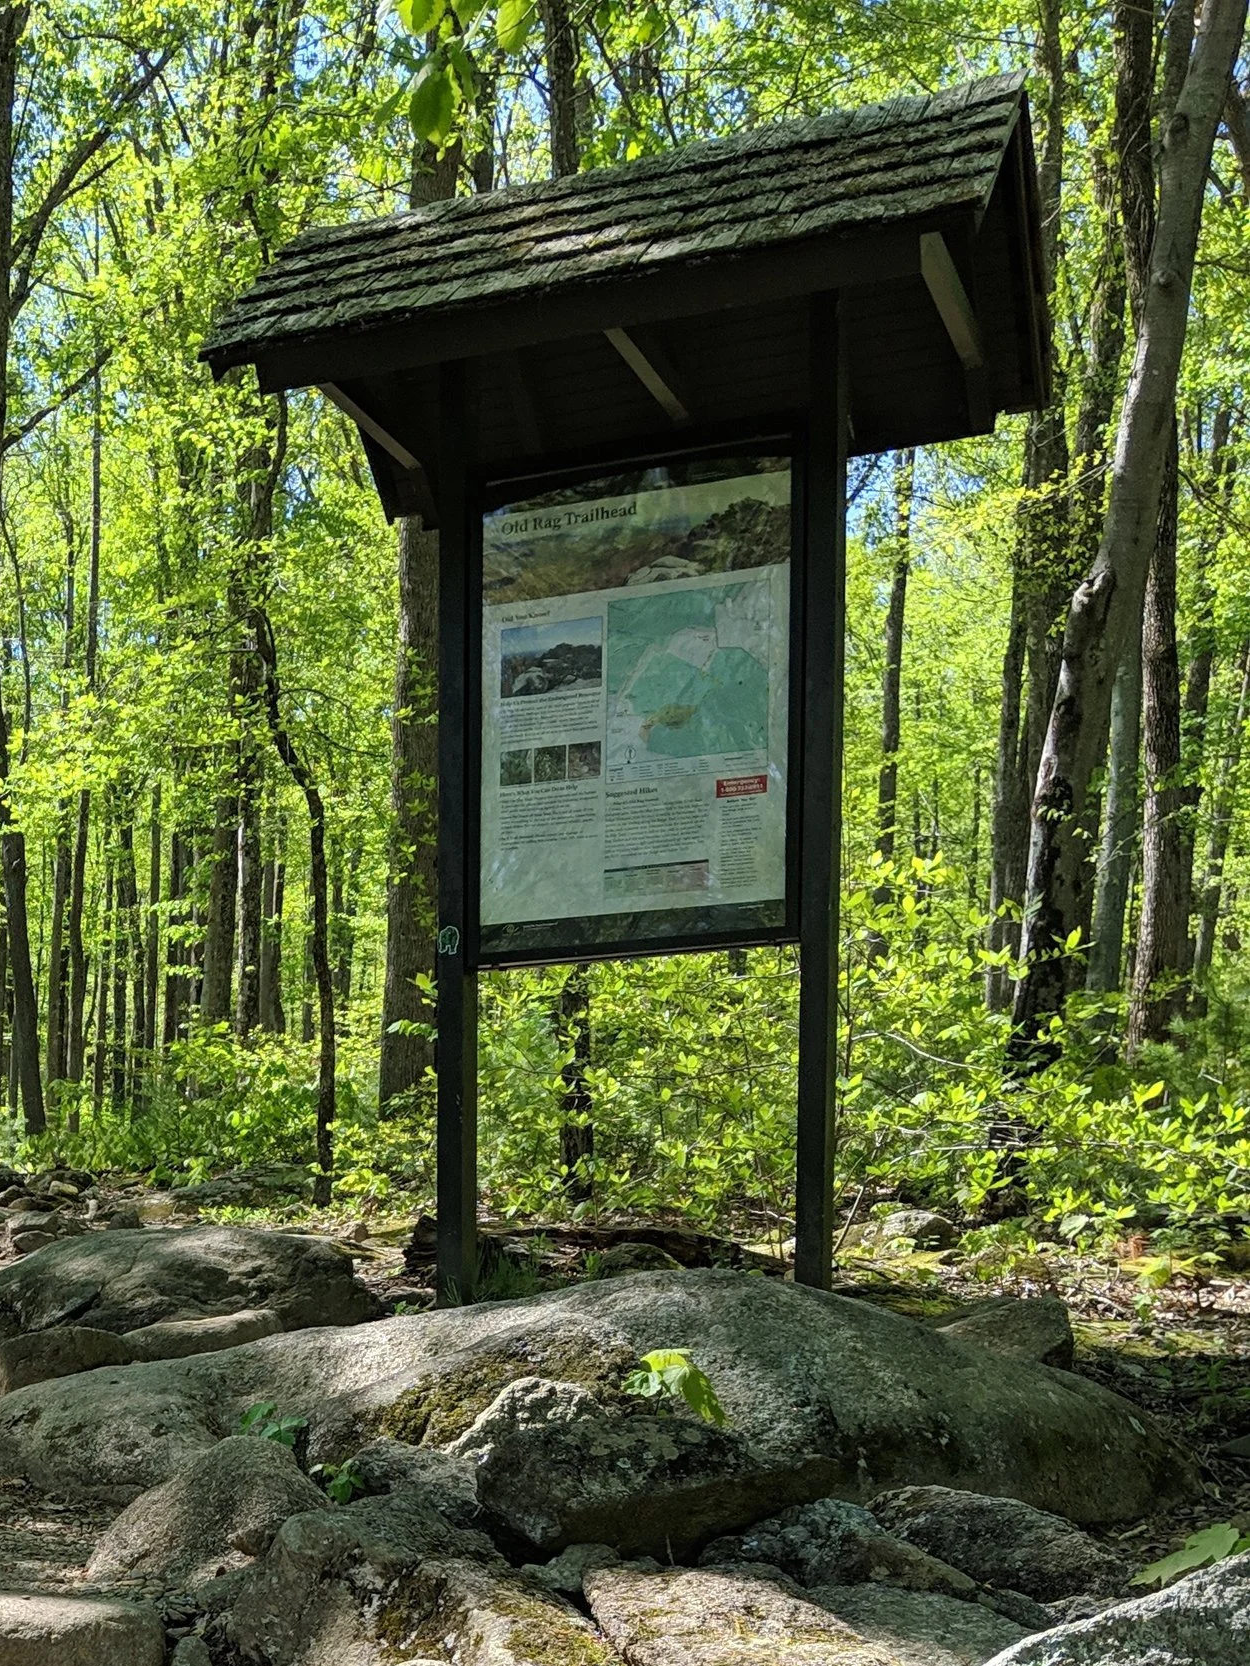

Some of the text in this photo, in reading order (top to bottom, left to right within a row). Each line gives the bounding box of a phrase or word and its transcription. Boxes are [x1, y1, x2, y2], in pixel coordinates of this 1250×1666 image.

[501, 501, 637, 535] Old Rag Trailhead
[605, 786, 658, 799] Suggested Hikes
